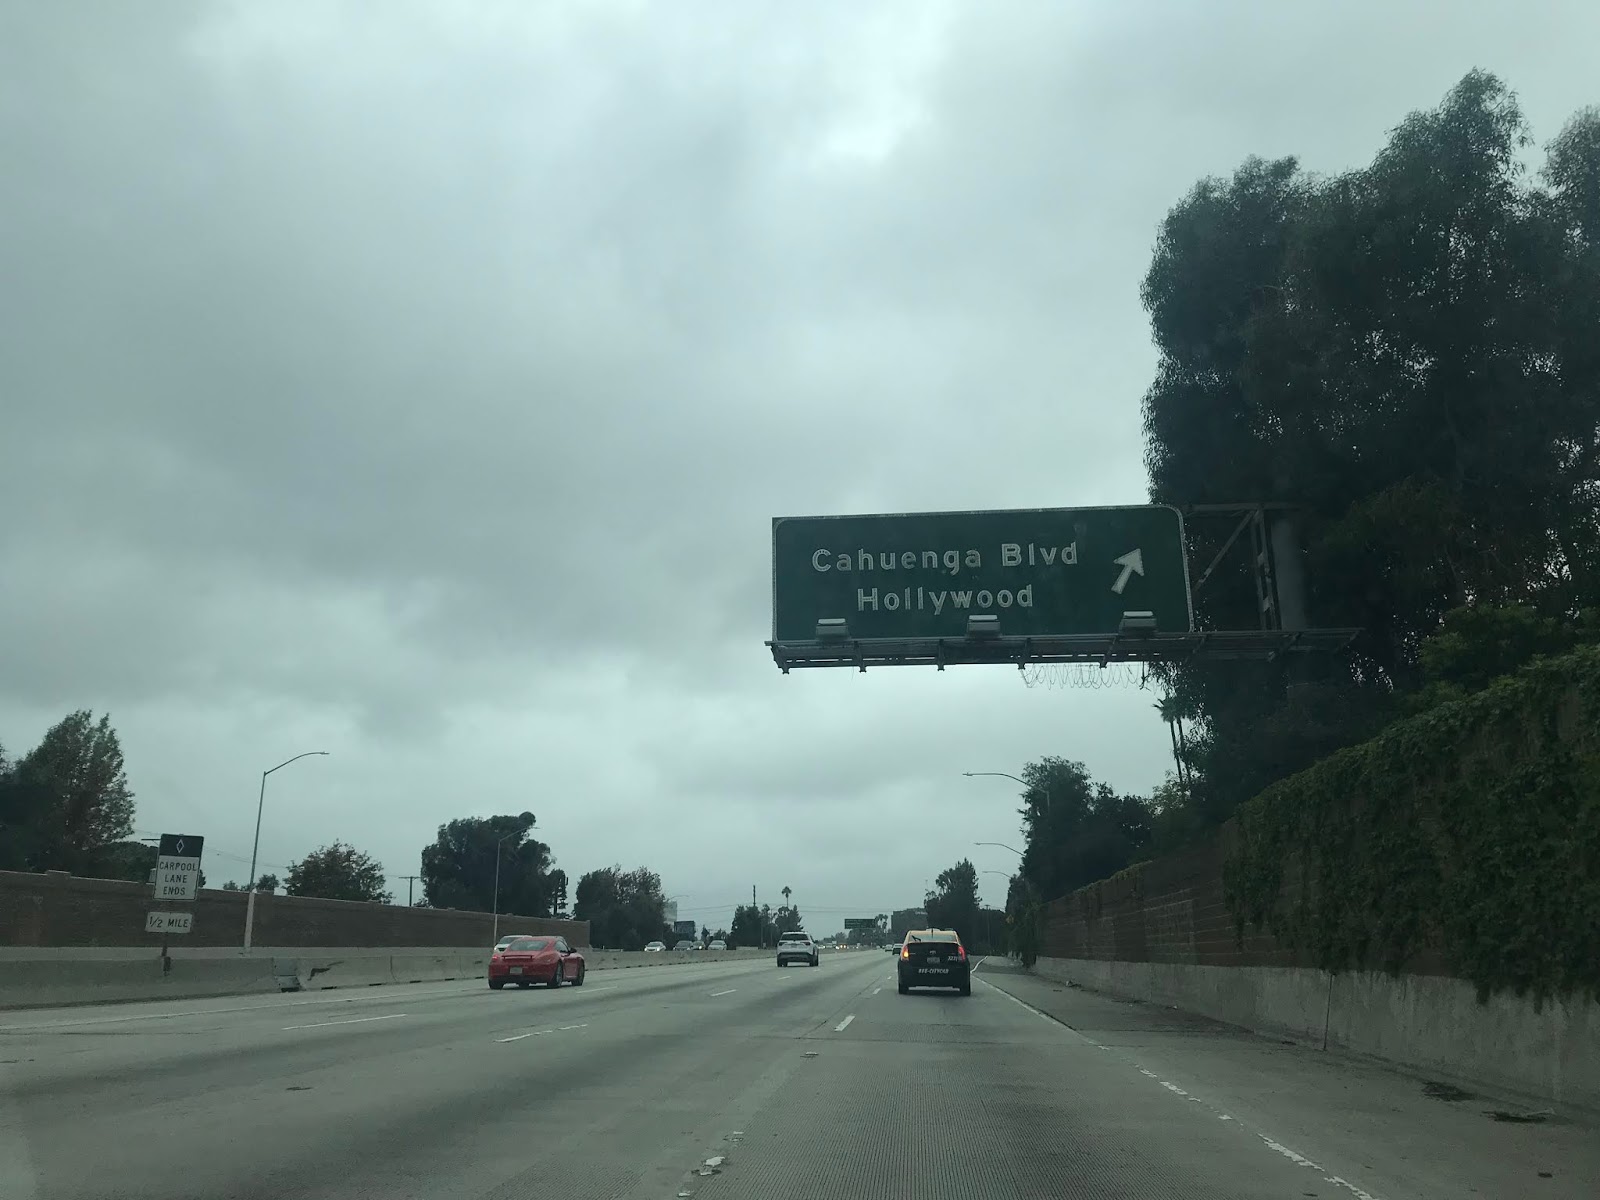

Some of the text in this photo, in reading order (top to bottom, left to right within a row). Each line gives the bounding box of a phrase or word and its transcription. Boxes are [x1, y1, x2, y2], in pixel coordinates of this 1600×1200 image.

[811, 541, 1079, 576] Cahuenga Blvd
[857, 583, 1034, 616] Hollywood
[159, 861, 197, 872] CARPOOL
[164, 874, 188, 884] LANE
[163, 886, 186, 896] ENDS
[149, 916, 188, 928] 1/2 MILE
